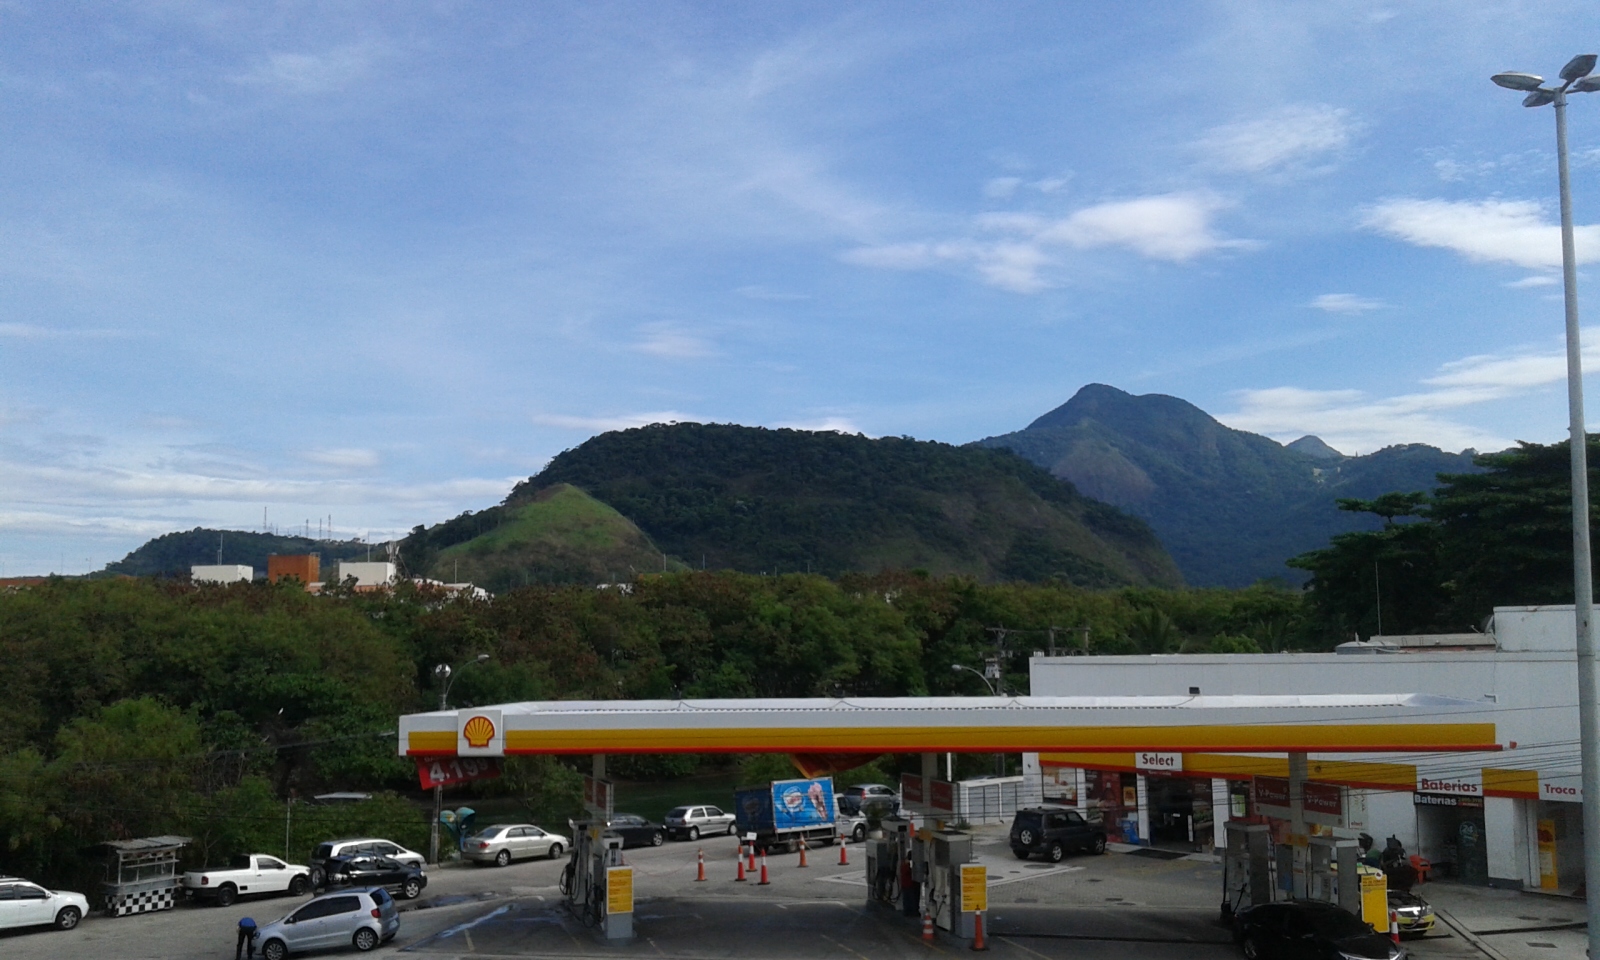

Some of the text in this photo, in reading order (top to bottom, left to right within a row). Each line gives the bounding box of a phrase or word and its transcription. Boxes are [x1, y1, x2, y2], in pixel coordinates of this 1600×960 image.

[1142, 753, 1174, 766] Select
[1421, 778, 1478, 793] Baterias
[1544, 783, 1576, 795] Troca
[1414, 794, 1457, 806] Baterias
